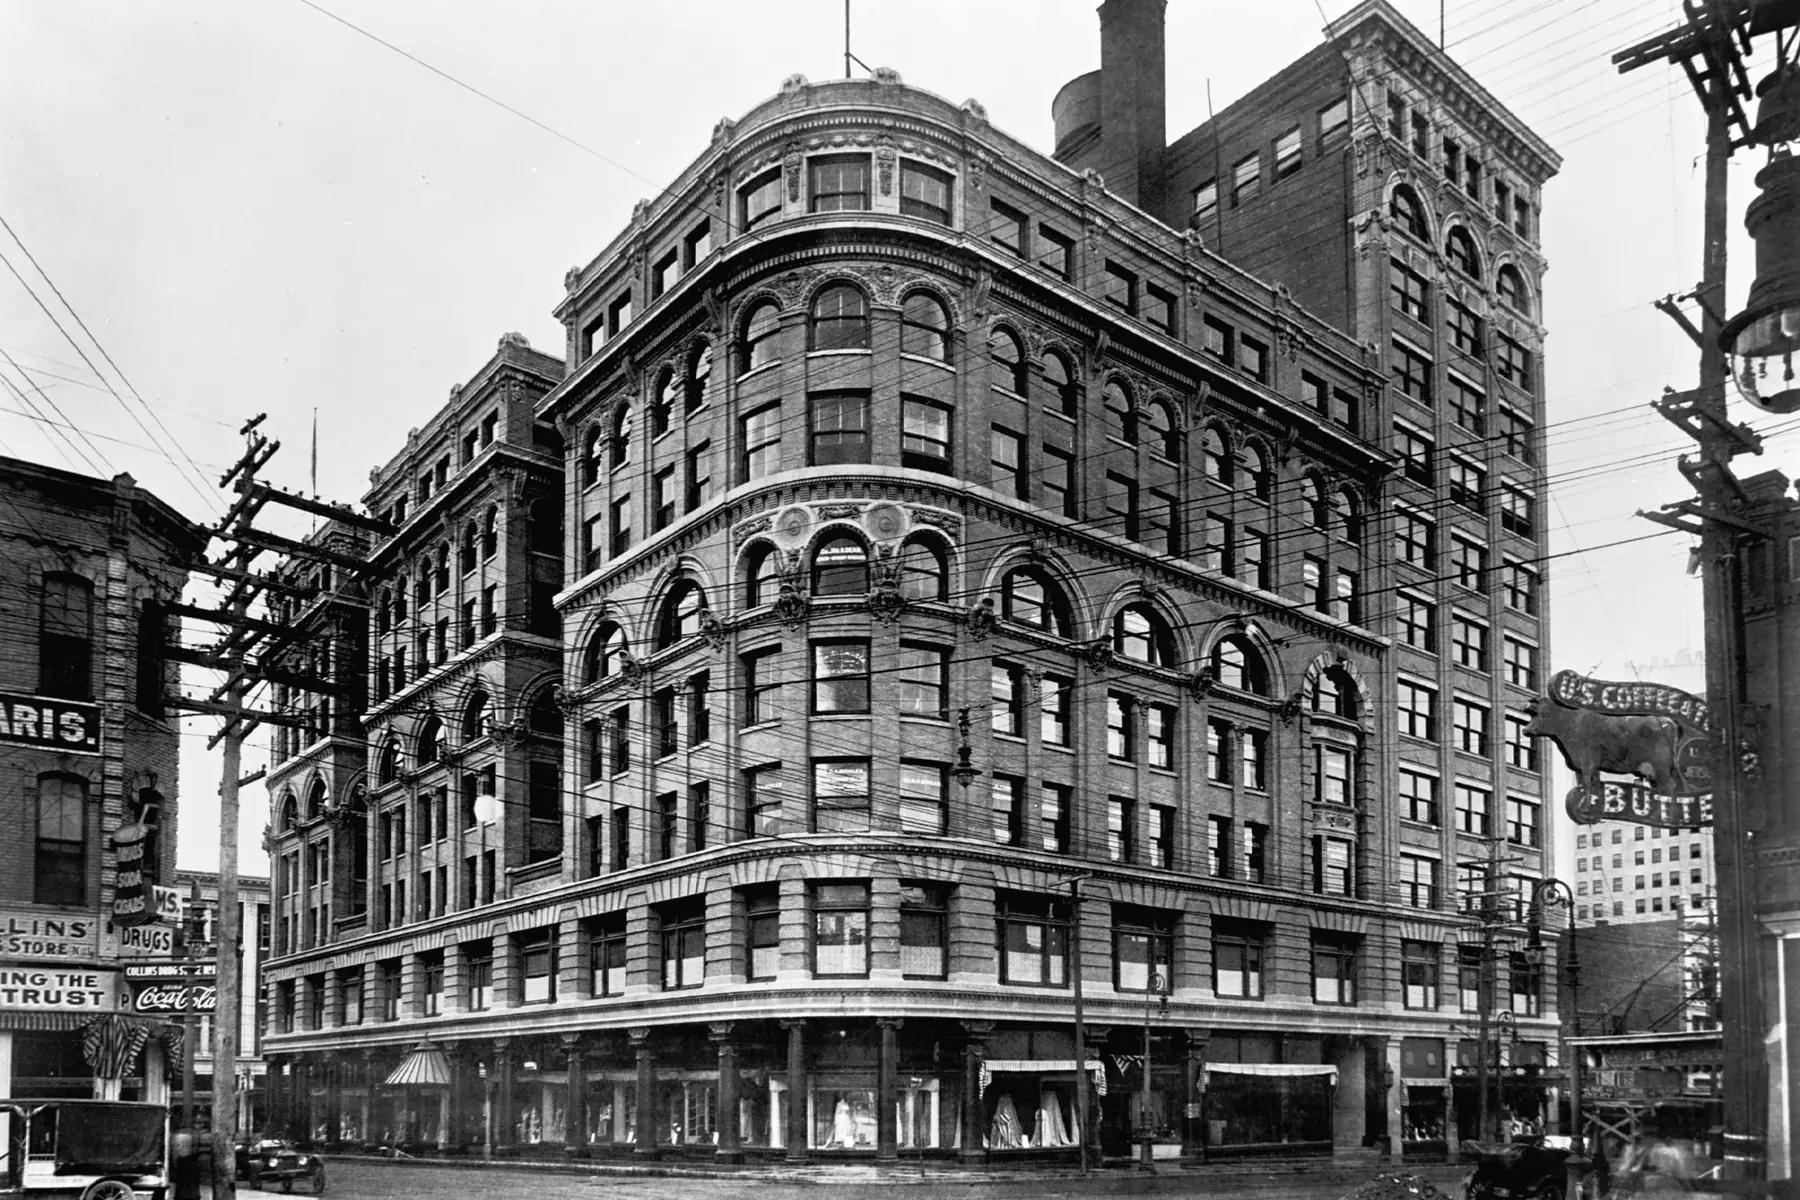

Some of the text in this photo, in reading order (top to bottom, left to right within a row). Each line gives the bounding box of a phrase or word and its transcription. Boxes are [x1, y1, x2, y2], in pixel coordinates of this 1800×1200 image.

[1602, 686, 1683, 715] COFFEE
[1604, 783, 1714, 823] BUTTE
[118, 870, 143, 888] SODA
[114, 895, 145, 915] CIGARS
[155, 889, 181, 914] MS.
[0, 918, 94, 938] LINS'
[8, 937, 69, 956] STORE
[122, 926, 170, 951] DRUGS
[1, 971, 98, 988] ING THE
[1, 988, 105, 1006] TRUST
